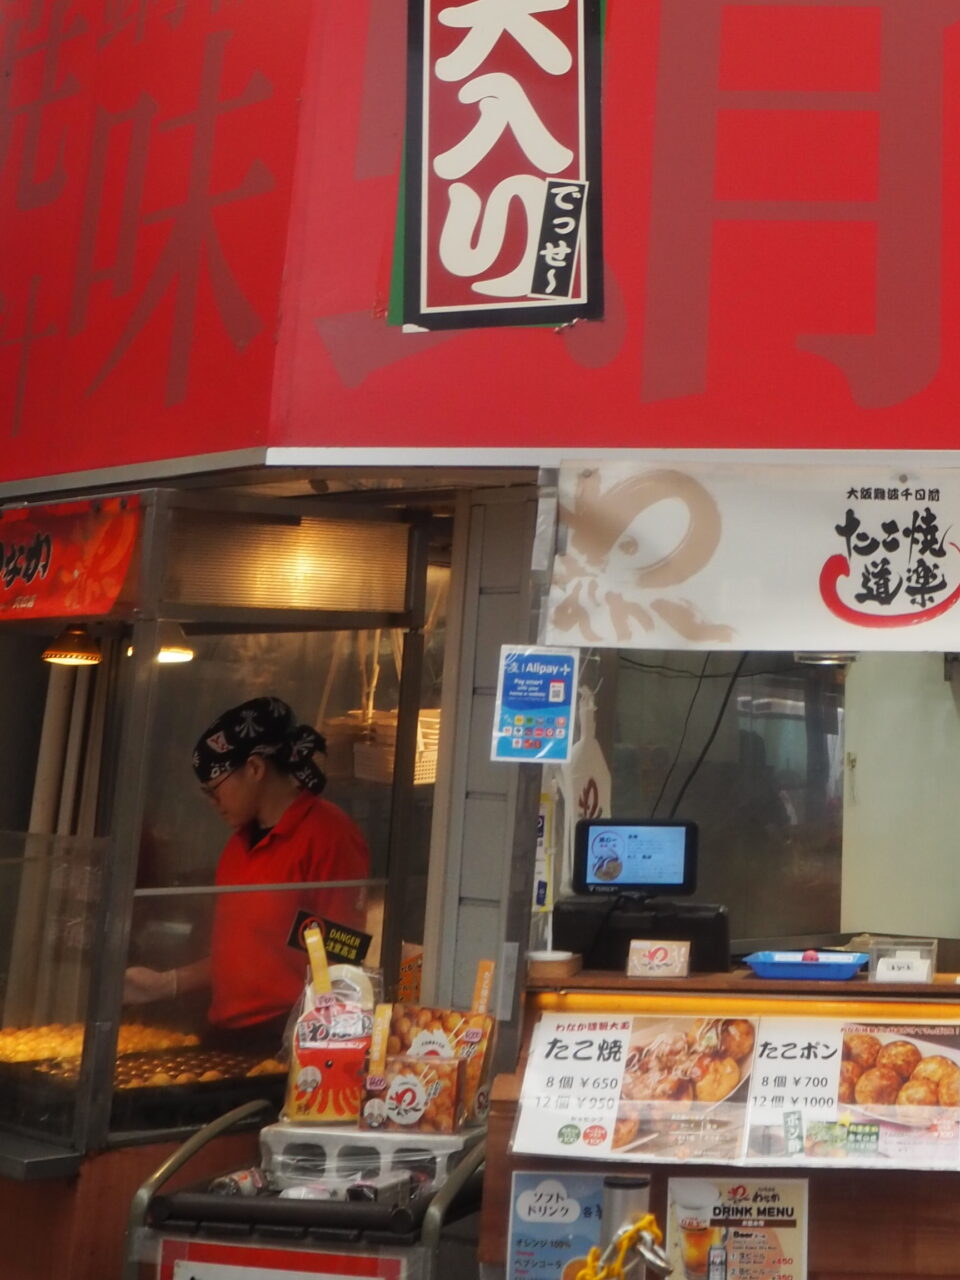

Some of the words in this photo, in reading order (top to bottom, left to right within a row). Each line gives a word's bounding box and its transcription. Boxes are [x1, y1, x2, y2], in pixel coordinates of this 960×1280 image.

[835, 508, 954, 559] たこ焼
[855, 556, 948, 608] 道楽
[329, 928, 361, 948] DANGER
[544, 1037, 623, 1062] たこ焼
[758, 1041, 838, 1060] たこポン
[534, 1192, 565, 1204] ソフト
[528, 1204, 569, 1218] ドリンク
[713, 1206, 753, 1218] DRINK
[756, 1206, 795, 1218] MENU
